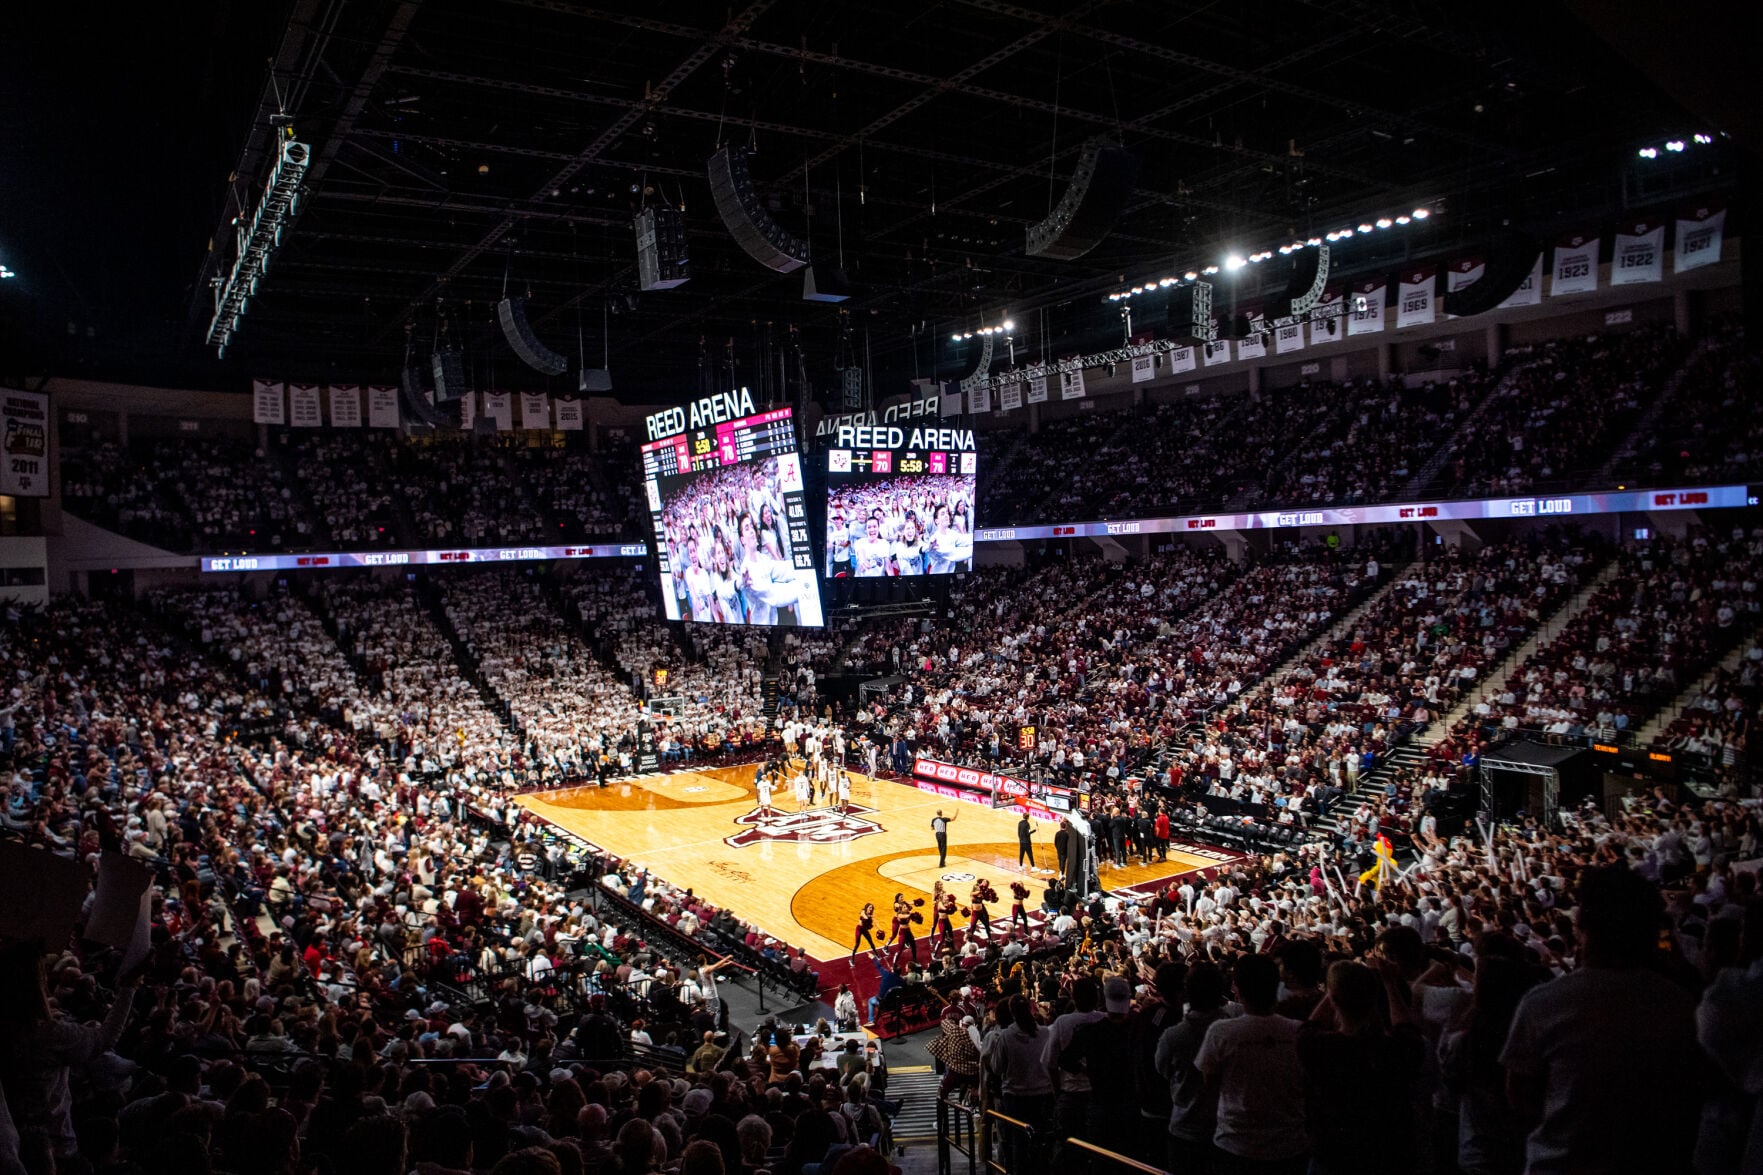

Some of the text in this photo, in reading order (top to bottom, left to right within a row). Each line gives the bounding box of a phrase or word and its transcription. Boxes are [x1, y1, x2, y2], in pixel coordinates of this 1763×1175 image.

[1683, 236, 1711, 254] 1921
[1619, 253, 1653, 268] 1922
[1558, 264, 1589, 280] 1923
[1402, 298, 1428, 313] 1969
[1353, 307, 1378, 321] 1975
[646, 386, 756, 441] REED ARENA
[838, 426, 976, 450] REED ARENA
[12, 459, 39, 474] 2011
[876, 461, 888, 471] 70
[900, 459, 923, 473] 5:58
[932, 462, 943, 473] 78
[1655, 492, 1708, 506] GET LOUD
[1399, 507, 1438, 518] GET LOUD
[1511, 499, 1572, 514] GET LOUD
[1188, 519, 1216, 529] GET LOUD
[1279, 512, 1323, 525] GET LOUD
[983, 530, 1015, 540] GET LOUD
[1053, 526, 1075, 535] GET LOUD
[1107, 523, 1140, 534] GET LOUD
[500, 549, 540, 559] GET LOUD
[620, 546, 637, 555] GET
[211, 558, 257, 570] GET LOUD
[365, 553, 409, 564] GET LOUD
[655, 676, 666, 684] 30
[1020, 735, 1034, 748] 30
